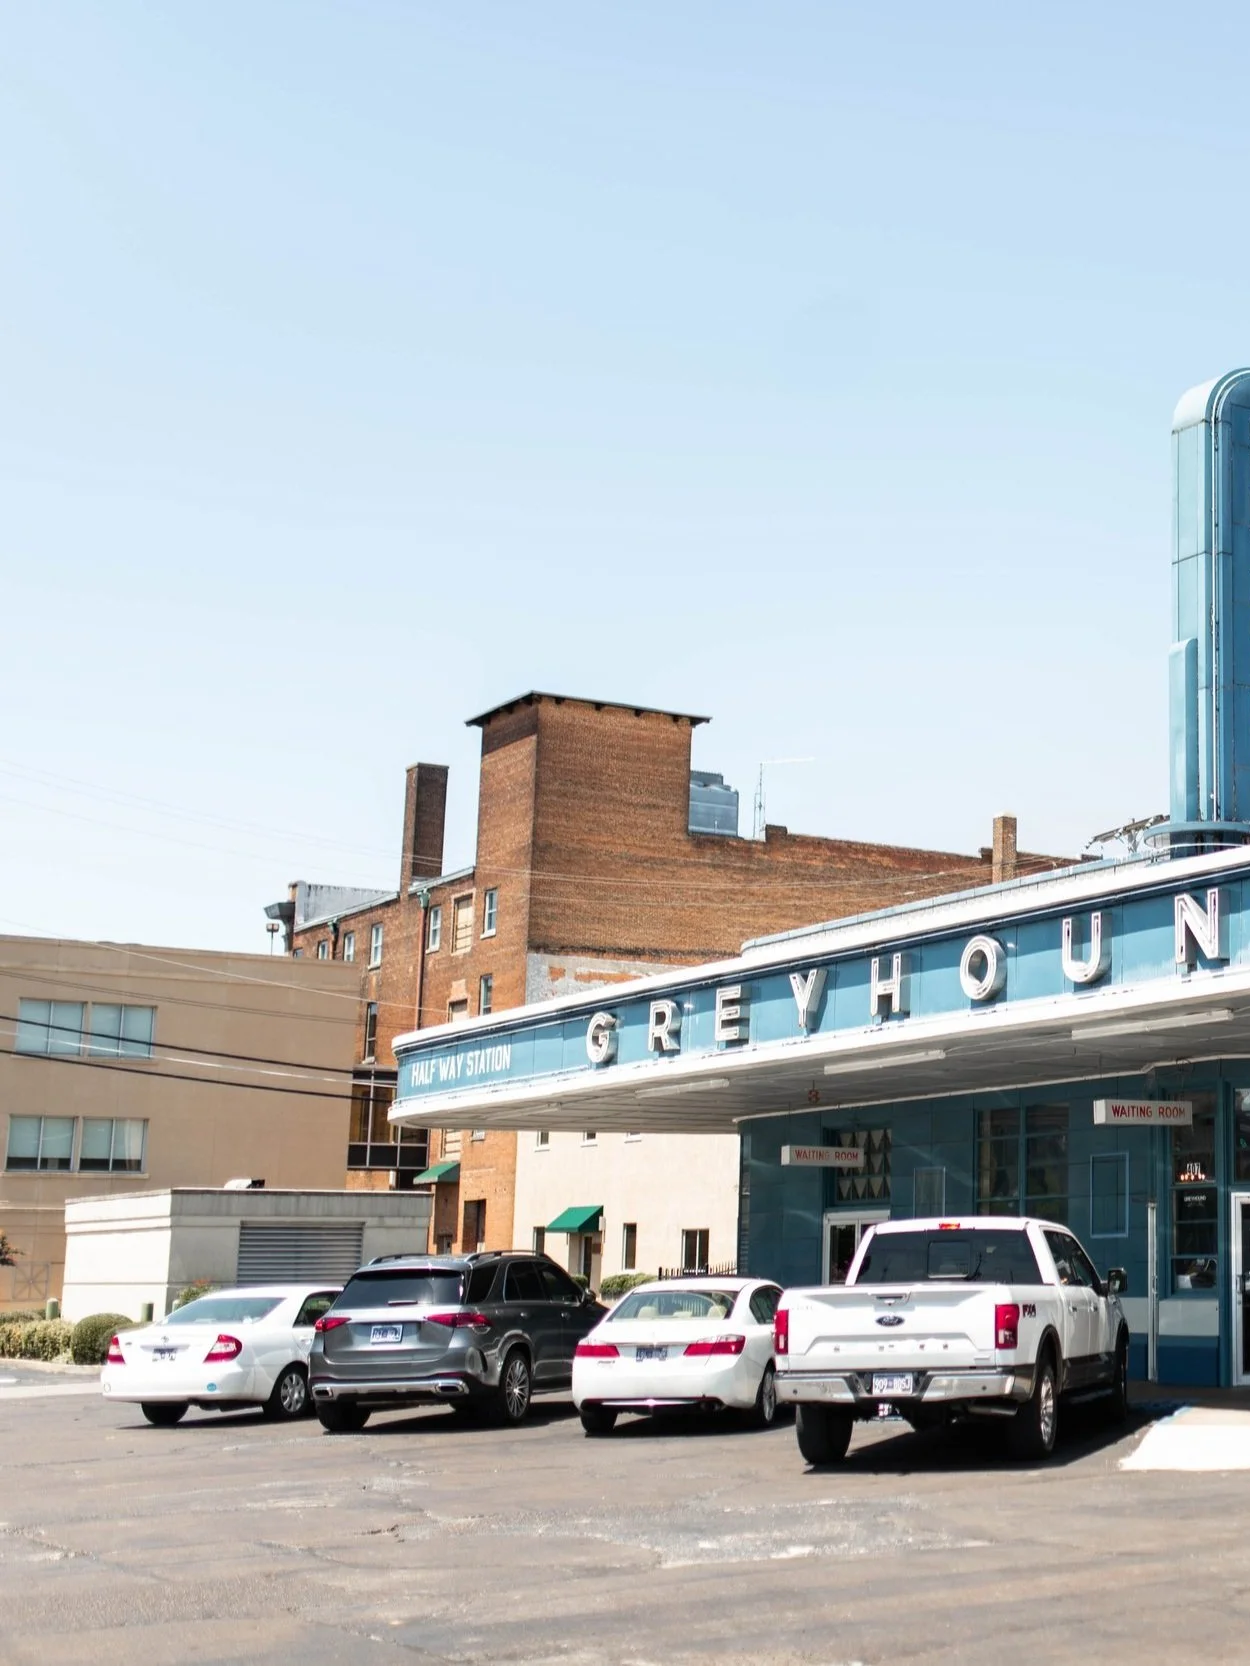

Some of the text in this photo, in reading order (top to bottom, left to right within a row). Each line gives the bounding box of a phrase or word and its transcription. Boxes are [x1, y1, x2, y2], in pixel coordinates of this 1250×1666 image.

[411, 1044, 511, 1087] HALF WAY STATION
[1111, 1105, 1186, 1119] WAITING ROOM
[794, 1149, 859, 1161] WAITING ROOM
[1186, 1162, 1201, 1177] 407
